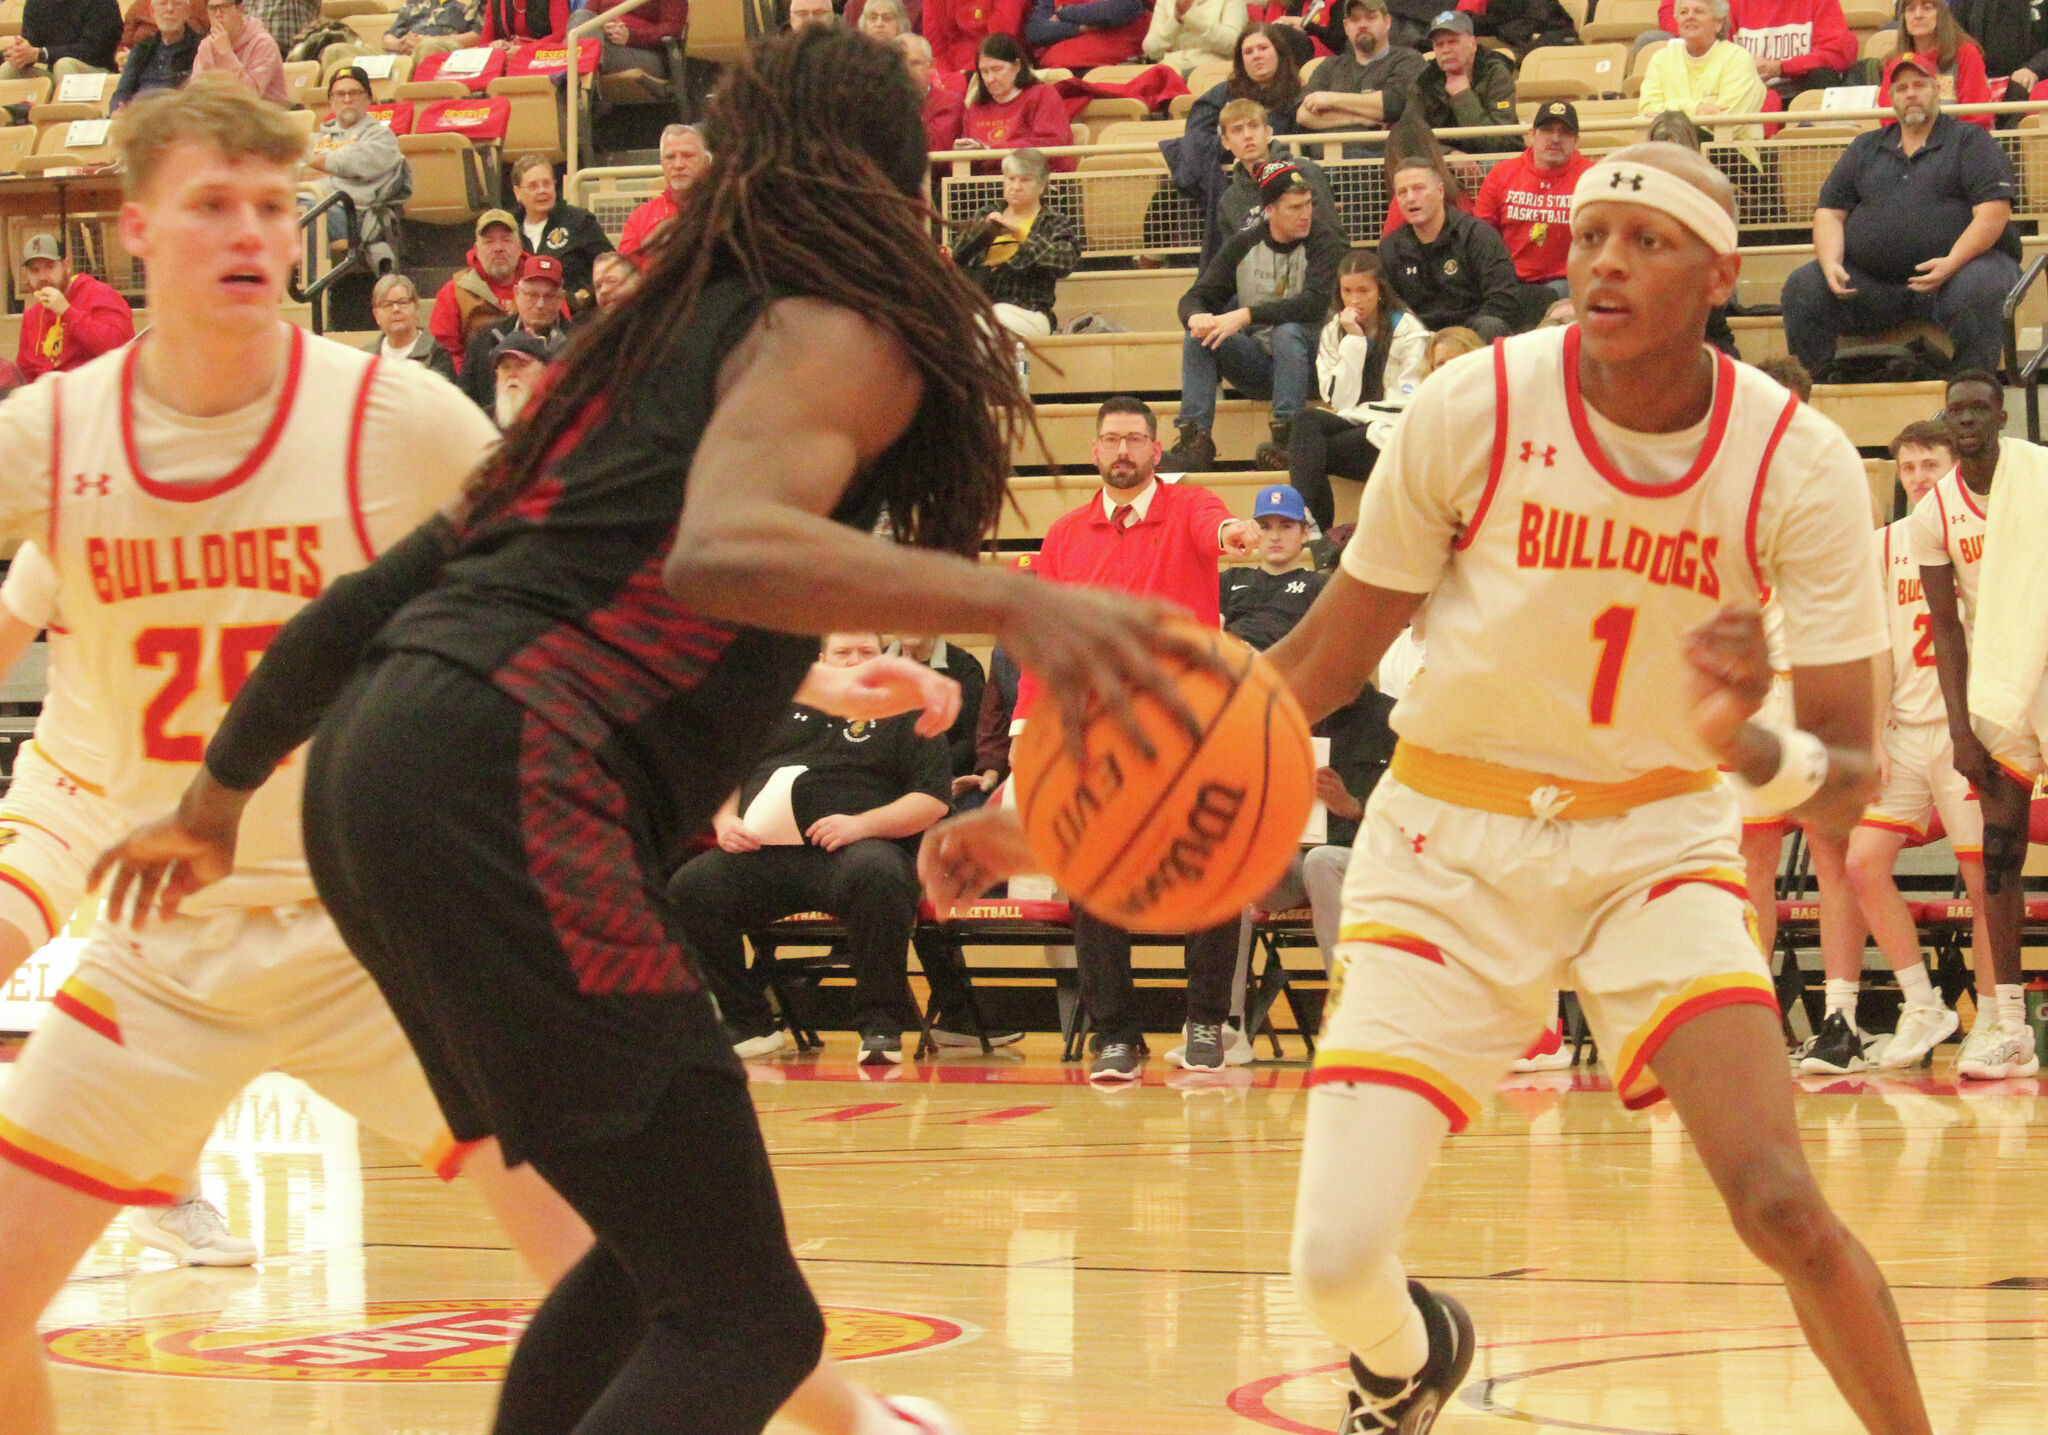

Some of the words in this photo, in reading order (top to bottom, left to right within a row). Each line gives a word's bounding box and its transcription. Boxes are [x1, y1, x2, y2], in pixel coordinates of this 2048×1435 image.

[535, 46, 583, 60] RESER
[1505, 190, 1545, 207] FERRIS
[1546, 194, 1573, 208] STAT
[1506, 205, 1570, 224] BASKETBAL
[86, 524, 322, 604] BULLDOGS
[1517, 500, 1720, 602] BULLDOGS
[1588, 602, 1639, 728] 1
[947, 906, 1023, 919] AKETBALL
[244, 1315, 530, 1365] LIAC
